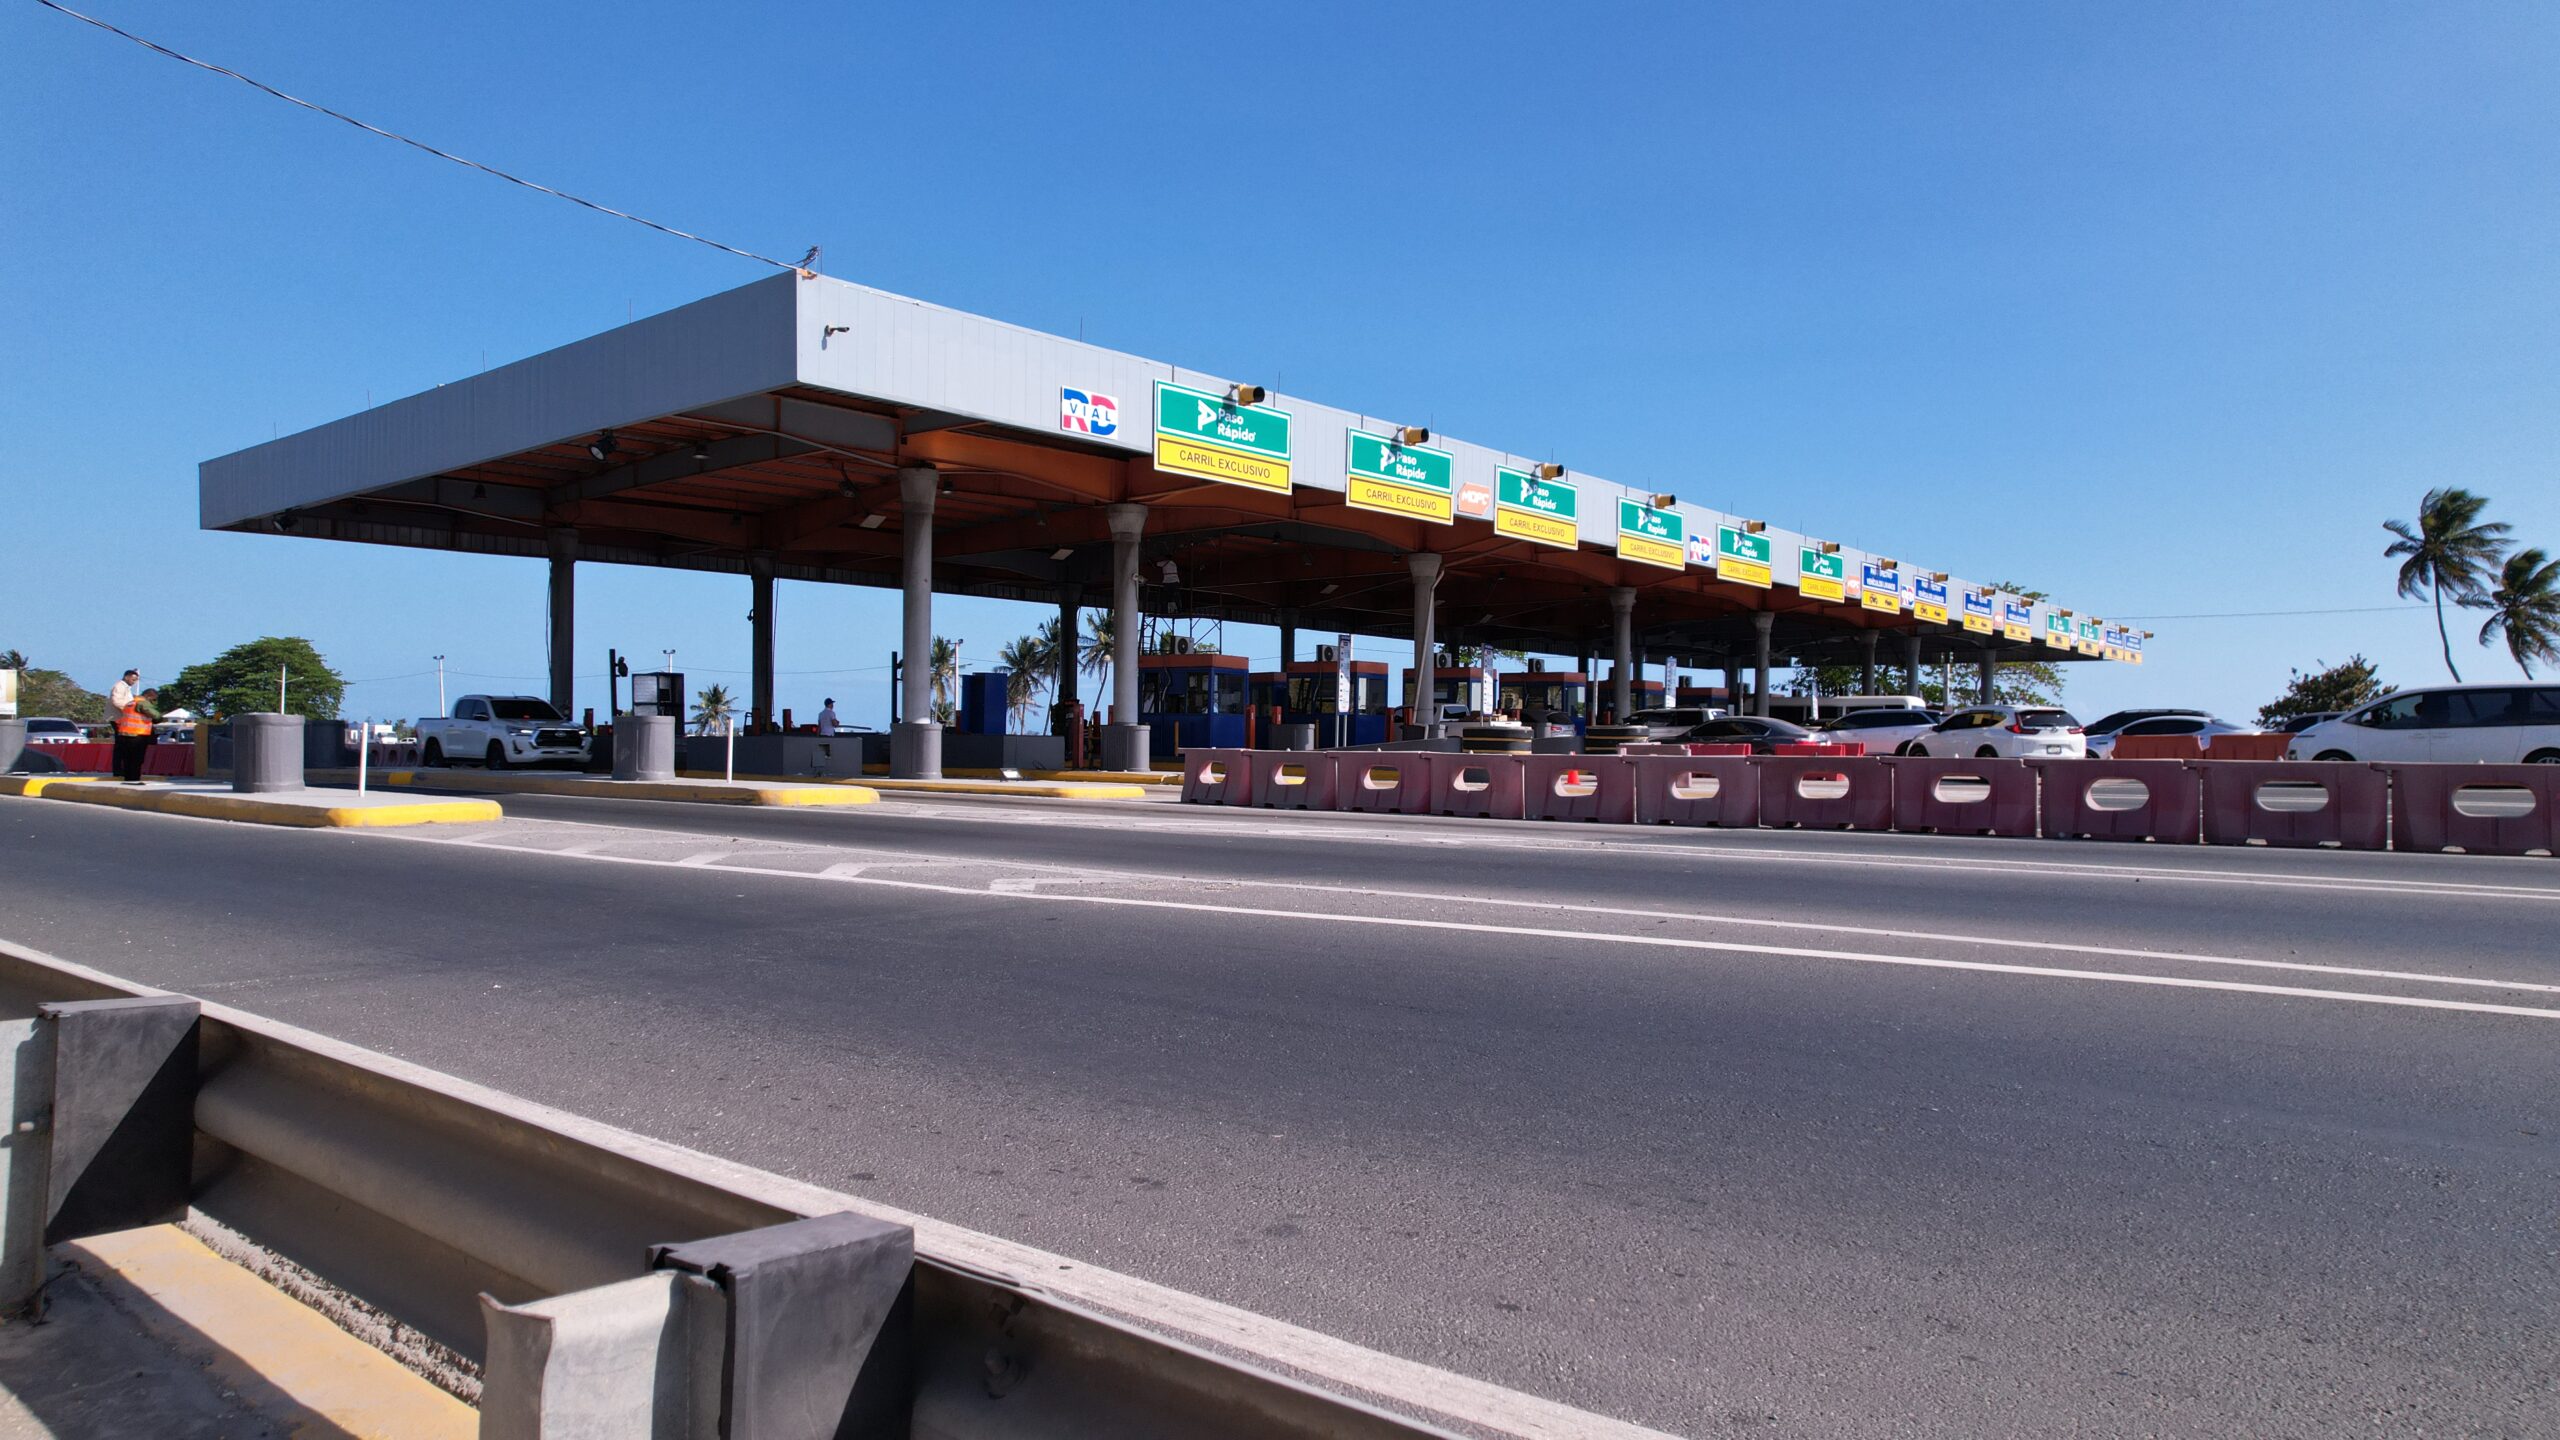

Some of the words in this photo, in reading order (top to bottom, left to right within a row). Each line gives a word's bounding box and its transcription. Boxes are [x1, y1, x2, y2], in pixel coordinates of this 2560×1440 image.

[1070, 402, 1111, 422] VIAL
[1218, 407, 1244, 425] Paso
[1217, 423, 1256, 442] Rápido
[1179, 450, 1215, 468] CARRIL
[1218, 458, 1271, 479] EXCLUSIVO
[1396, 451, 1417, 465] Paso
[1396, 464, 1426, 480] Rápido
[1366, 488, 1394, 502] CARRIL
[1396, 494, 1437, 511] EXCLUSIVO
[1533, 484, 1549, 497] Paso
[1532, 495, 1557, 510] Rápido
[1509, 518, 1531, 530] CARRIL
[1533, 523, 1565, 537] EXCLUSIVO
